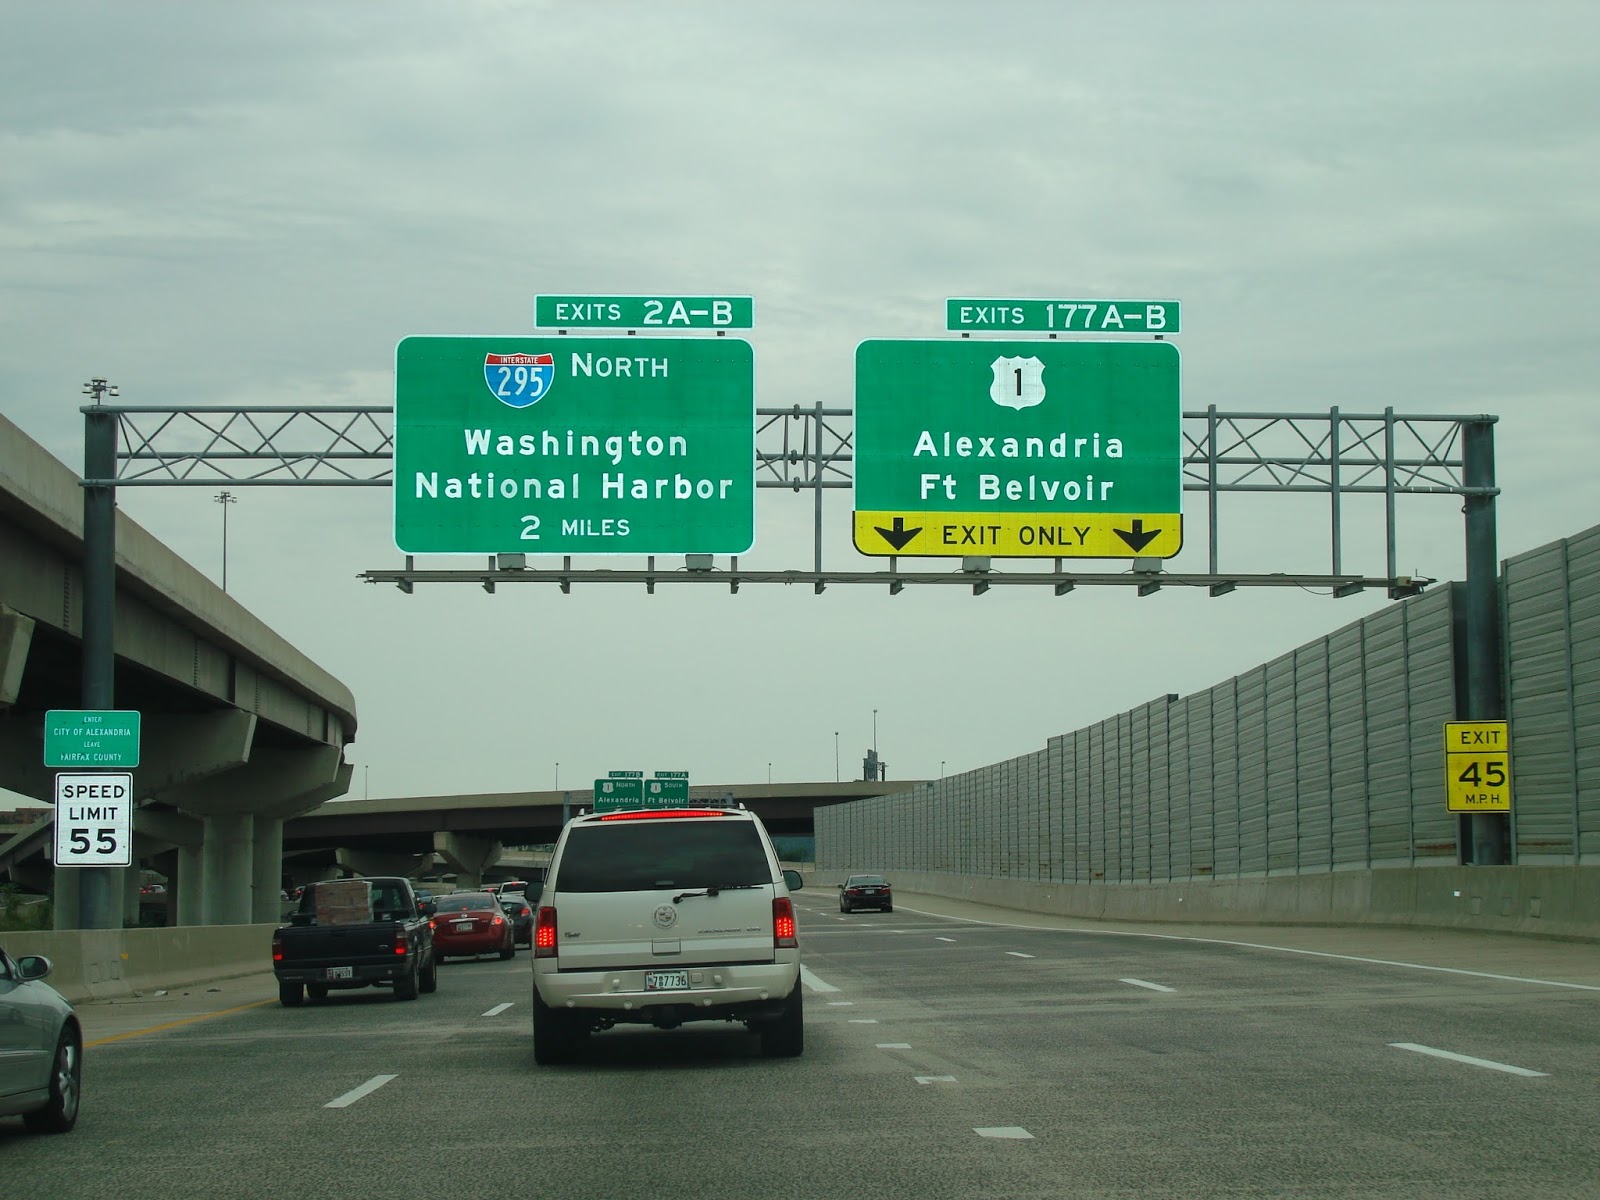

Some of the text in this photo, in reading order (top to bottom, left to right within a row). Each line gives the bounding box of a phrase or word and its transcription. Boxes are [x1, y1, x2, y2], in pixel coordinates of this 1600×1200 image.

[556, 300, 733, 325] EXITS 2A-B
[960, 304, 1167, 329] EXITS 177A-B
[500, 356, 539, 364] INTERSTATE
[571, 352, 668, 378] NORTH
[497, 367, 544, 397] 295
[1013, 368, 1022, 397] 1
[464, 429, 688, 466] Washington
[913, 430, 1124, 458] Alexandria
[415, 472, 733, 499] National Harbor
[920, 474, 1114, 502] Ft Belvoir
[519, 515, 631, 540] 2 MILES
[942, 525, 1091, 546] EXIT ONLY
[53, 728, 70, 736] CITY
[73, 728, 83, 736] OF
[1461, 731, 1500, 744] EXIT
[60, 753, 123, 761] FAIRFAX COUNTY
[1459, 762, 1506, 787] 45
[64, 785, 124, 798] SPEED
[69, 807, 118, 820] LIMIT
[70, 828, 117, 855] 55
